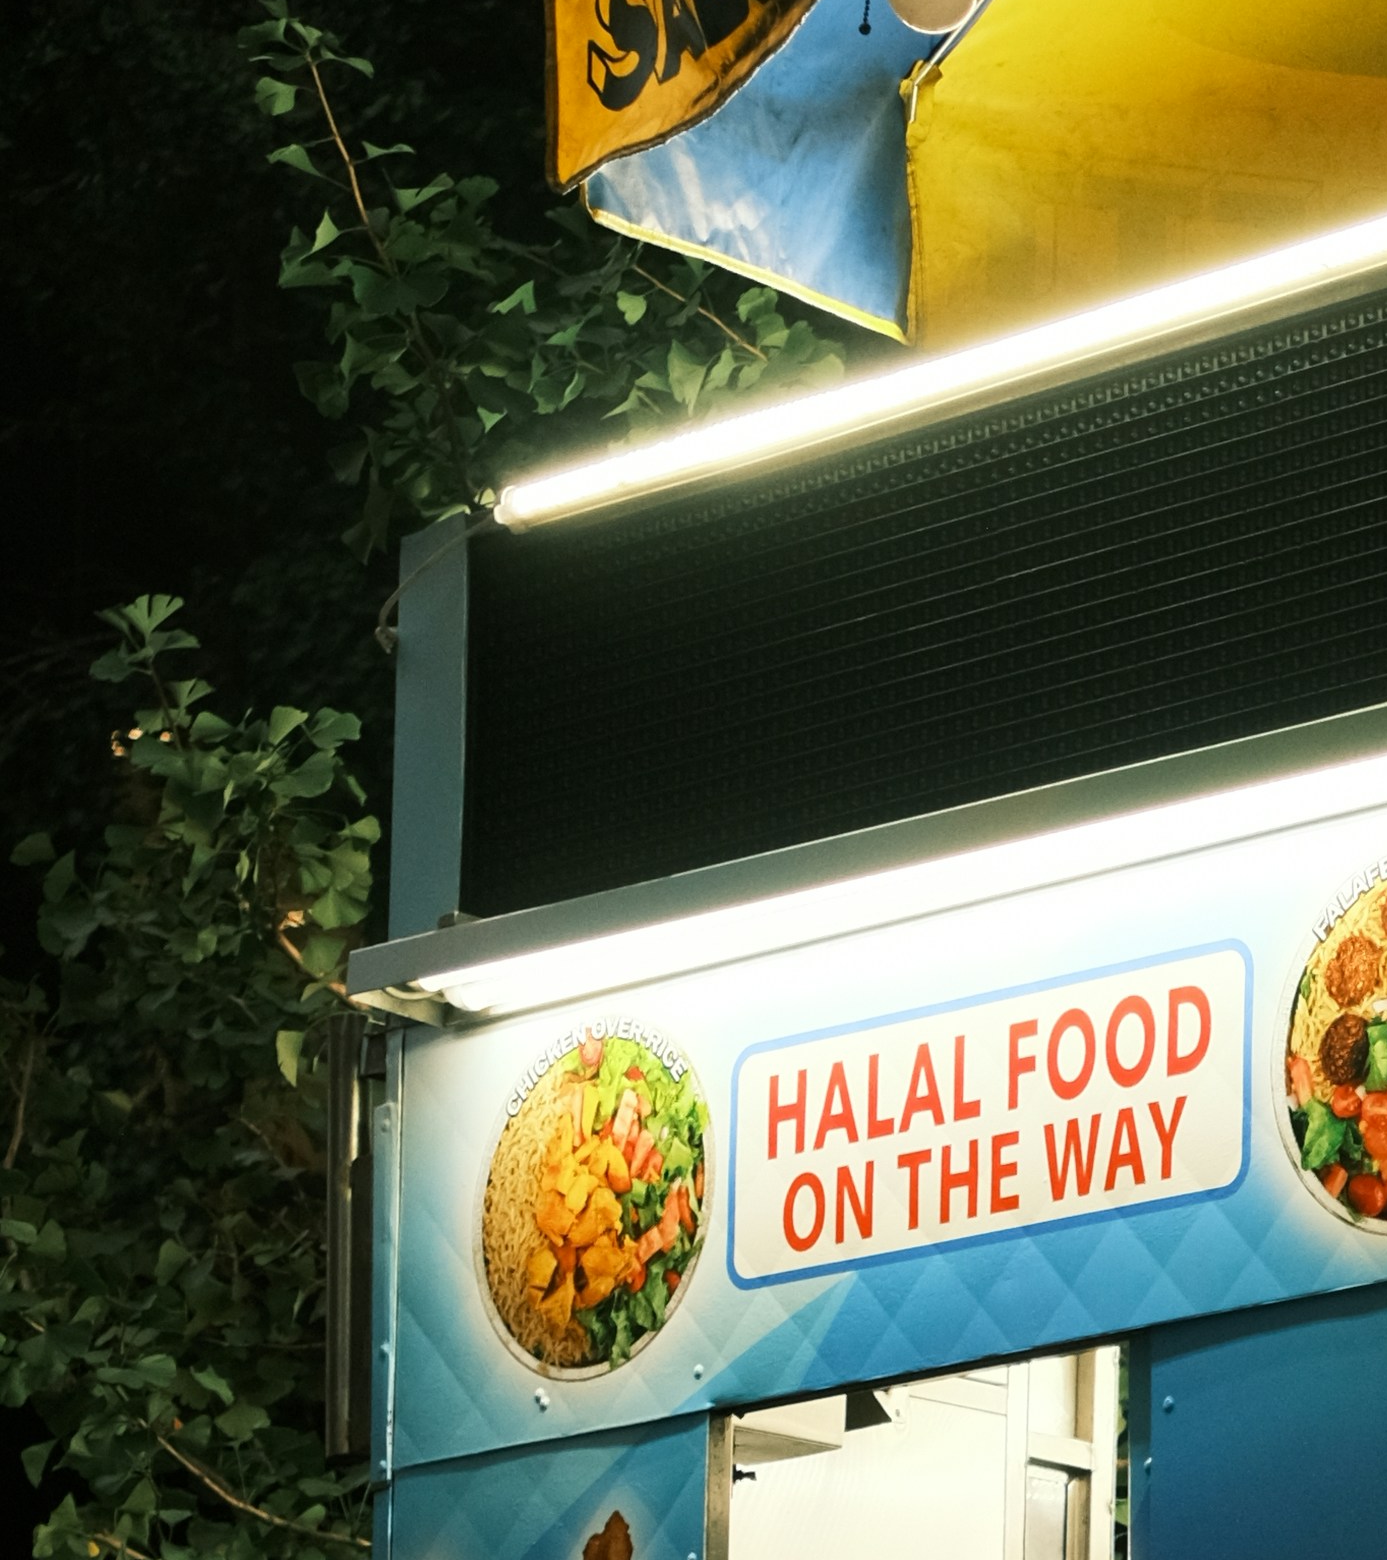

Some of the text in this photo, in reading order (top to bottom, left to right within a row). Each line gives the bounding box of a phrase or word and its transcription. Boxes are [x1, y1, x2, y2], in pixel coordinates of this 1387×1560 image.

[505, 1017, 688, 1118] CHICKEN OVER RICE
[766, 983, 1212, 1162] HALAL FOOD
[783, 1095, 1187, 1252] ON THE WAY
